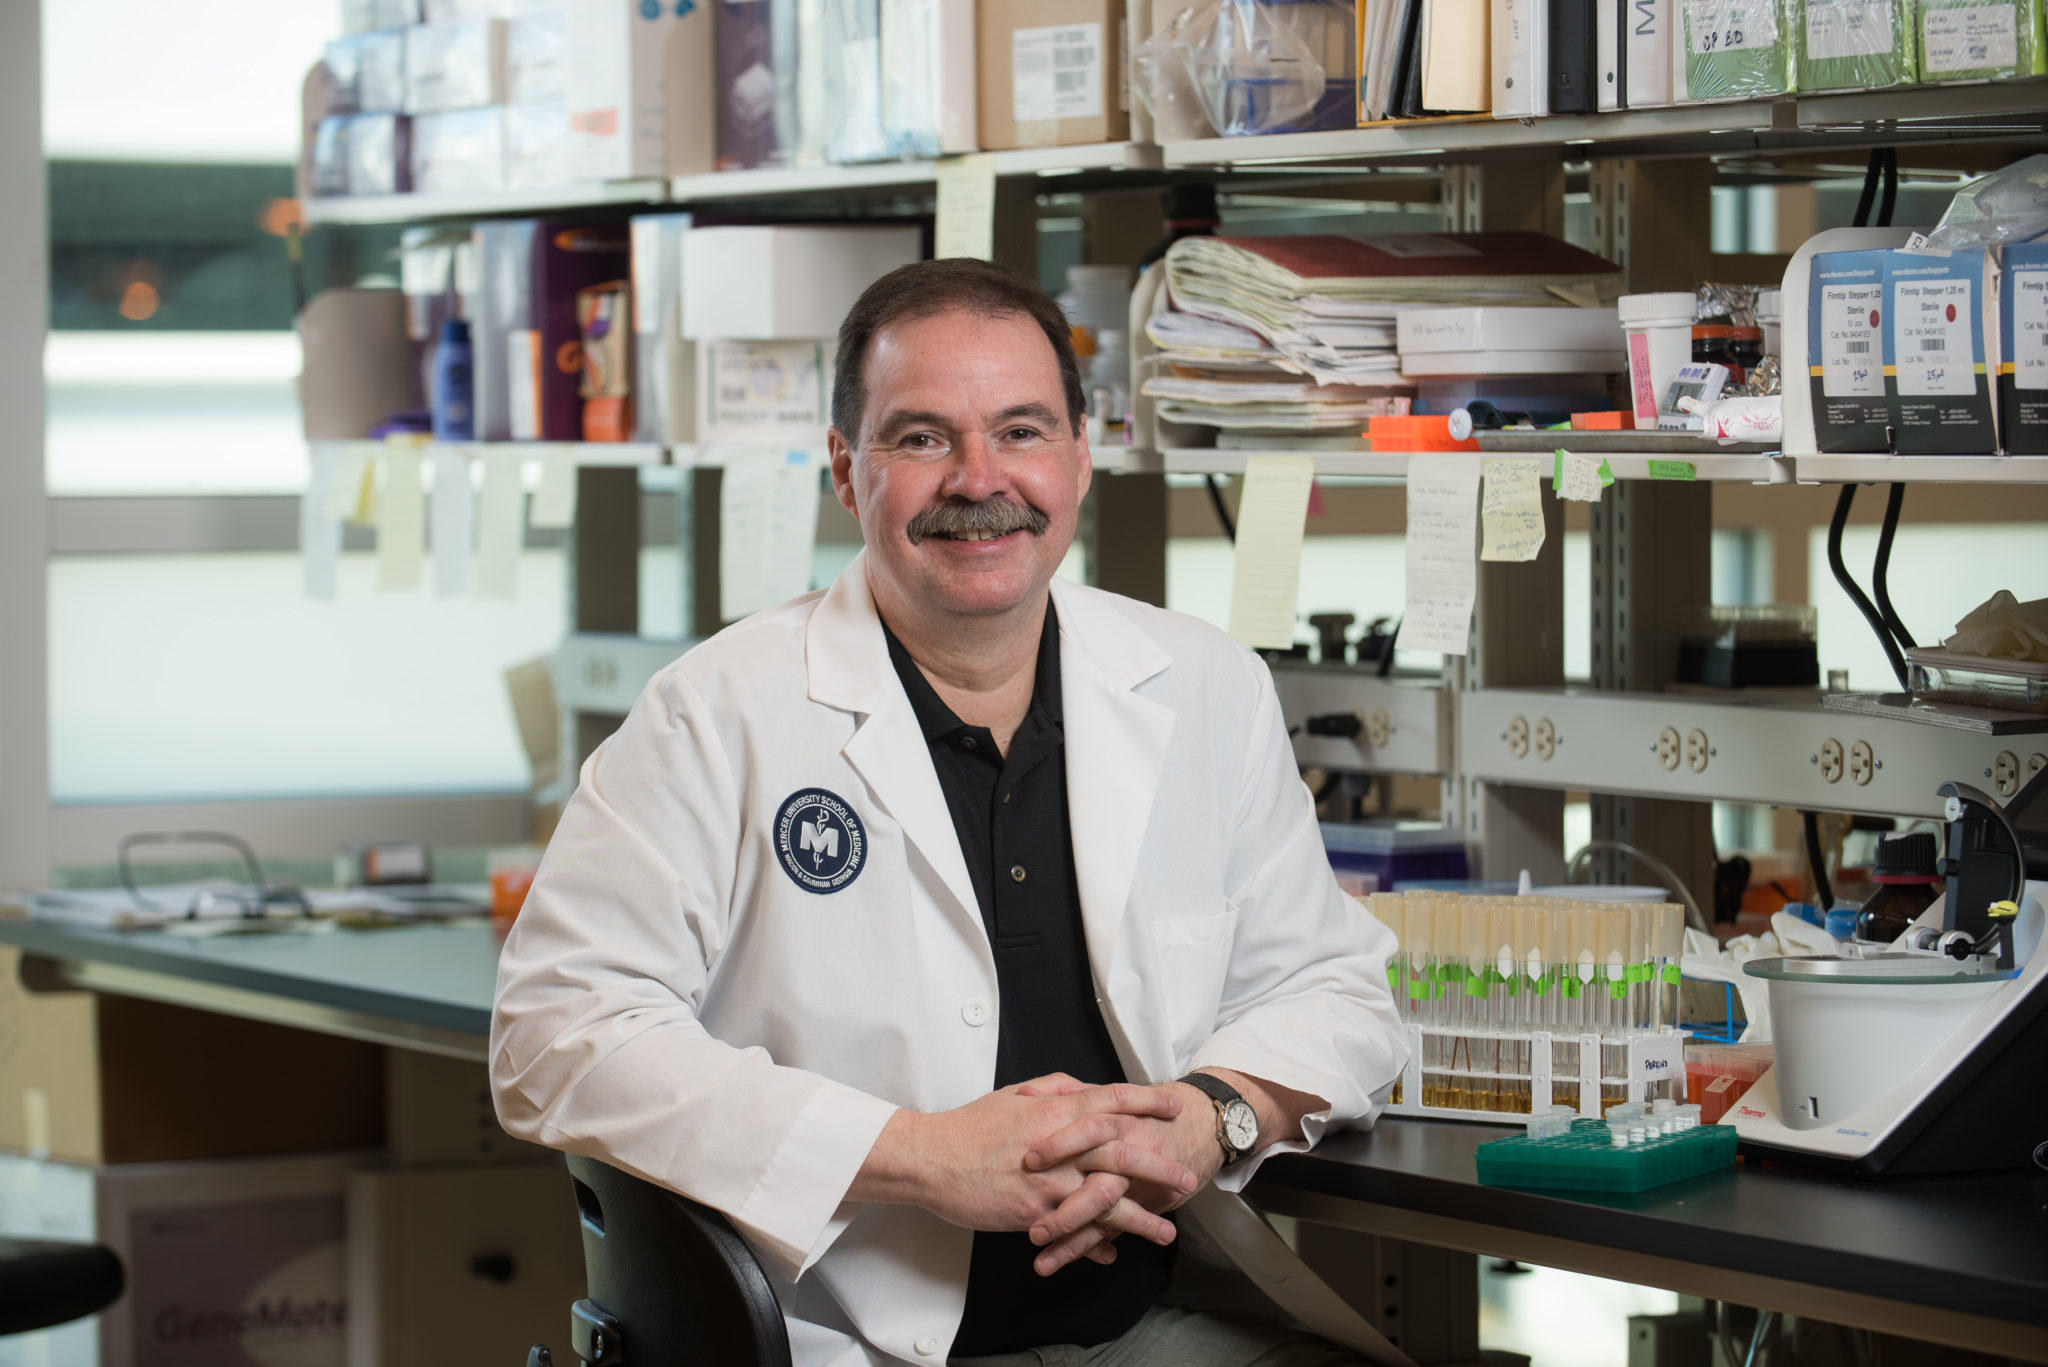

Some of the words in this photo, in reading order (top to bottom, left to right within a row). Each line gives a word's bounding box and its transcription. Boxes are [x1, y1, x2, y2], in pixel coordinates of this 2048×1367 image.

[1901, 288, 1920, 296] Finntip
[1922, 287, 1944, 296] Stepper
[2022, 282, 2044, 292] Finntip
[1828, 291, 1846, 300] Finntip
[1848, 291, 1869, 300] Stepper
[1847, 306, 1865, 314] Sterile
[1921, 303, 1939, 311] Sterile
[785, 794, 820, 818] UNIVERSITY
[821, 795, 848, 819] SCHOOL
[846, 818, 857, 829] OF
[780, 817, 791, 852] MERCER
[849, 827, 862, 870] MEDICINE
[1737, 1105, 1767, 1118] Thermo
